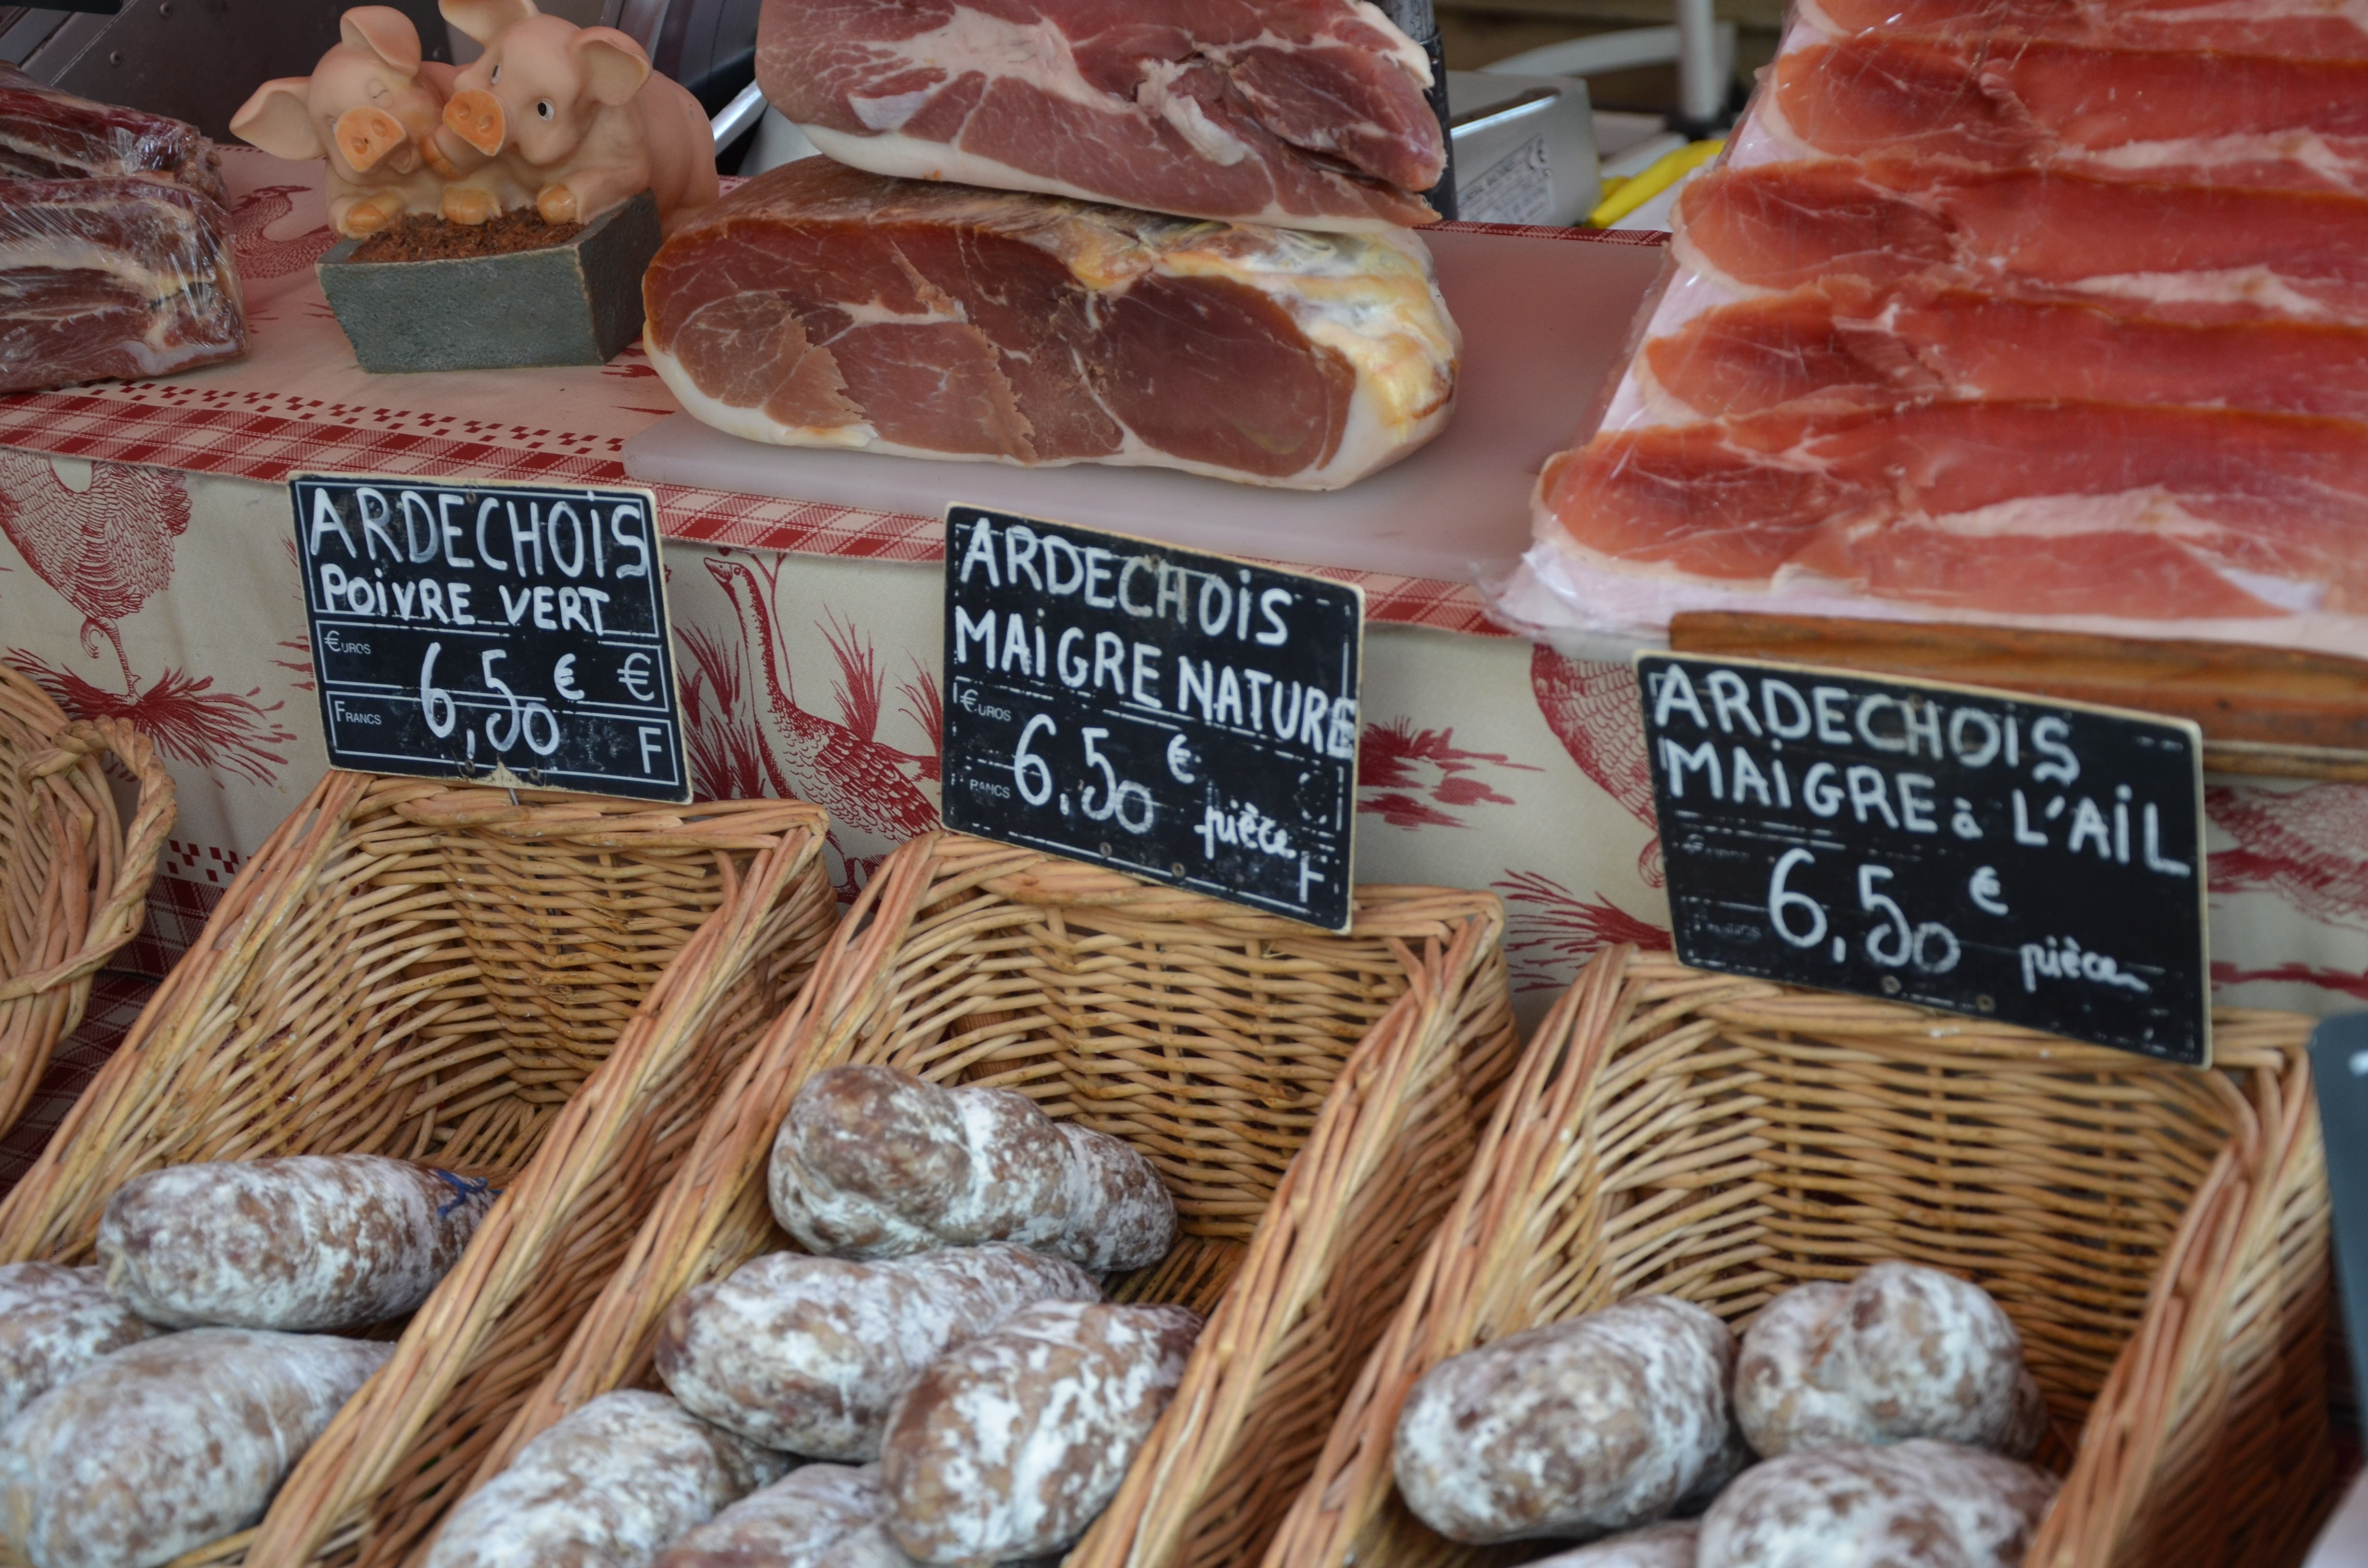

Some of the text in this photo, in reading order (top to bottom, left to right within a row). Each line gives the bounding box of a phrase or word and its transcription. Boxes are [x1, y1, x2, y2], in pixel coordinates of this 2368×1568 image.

[499, 585, 609, 636] VERT
[554, 653, 585, 700] €
[617, 652, 654, 701] €
[1177, 656, 1357, 759] NATURE
[638, 726, 662, 773] F
[1168, 734, 1195, 784] €
[965, 766, 1010, 798] RANCS
[1969, 866, 2009, 914] €
